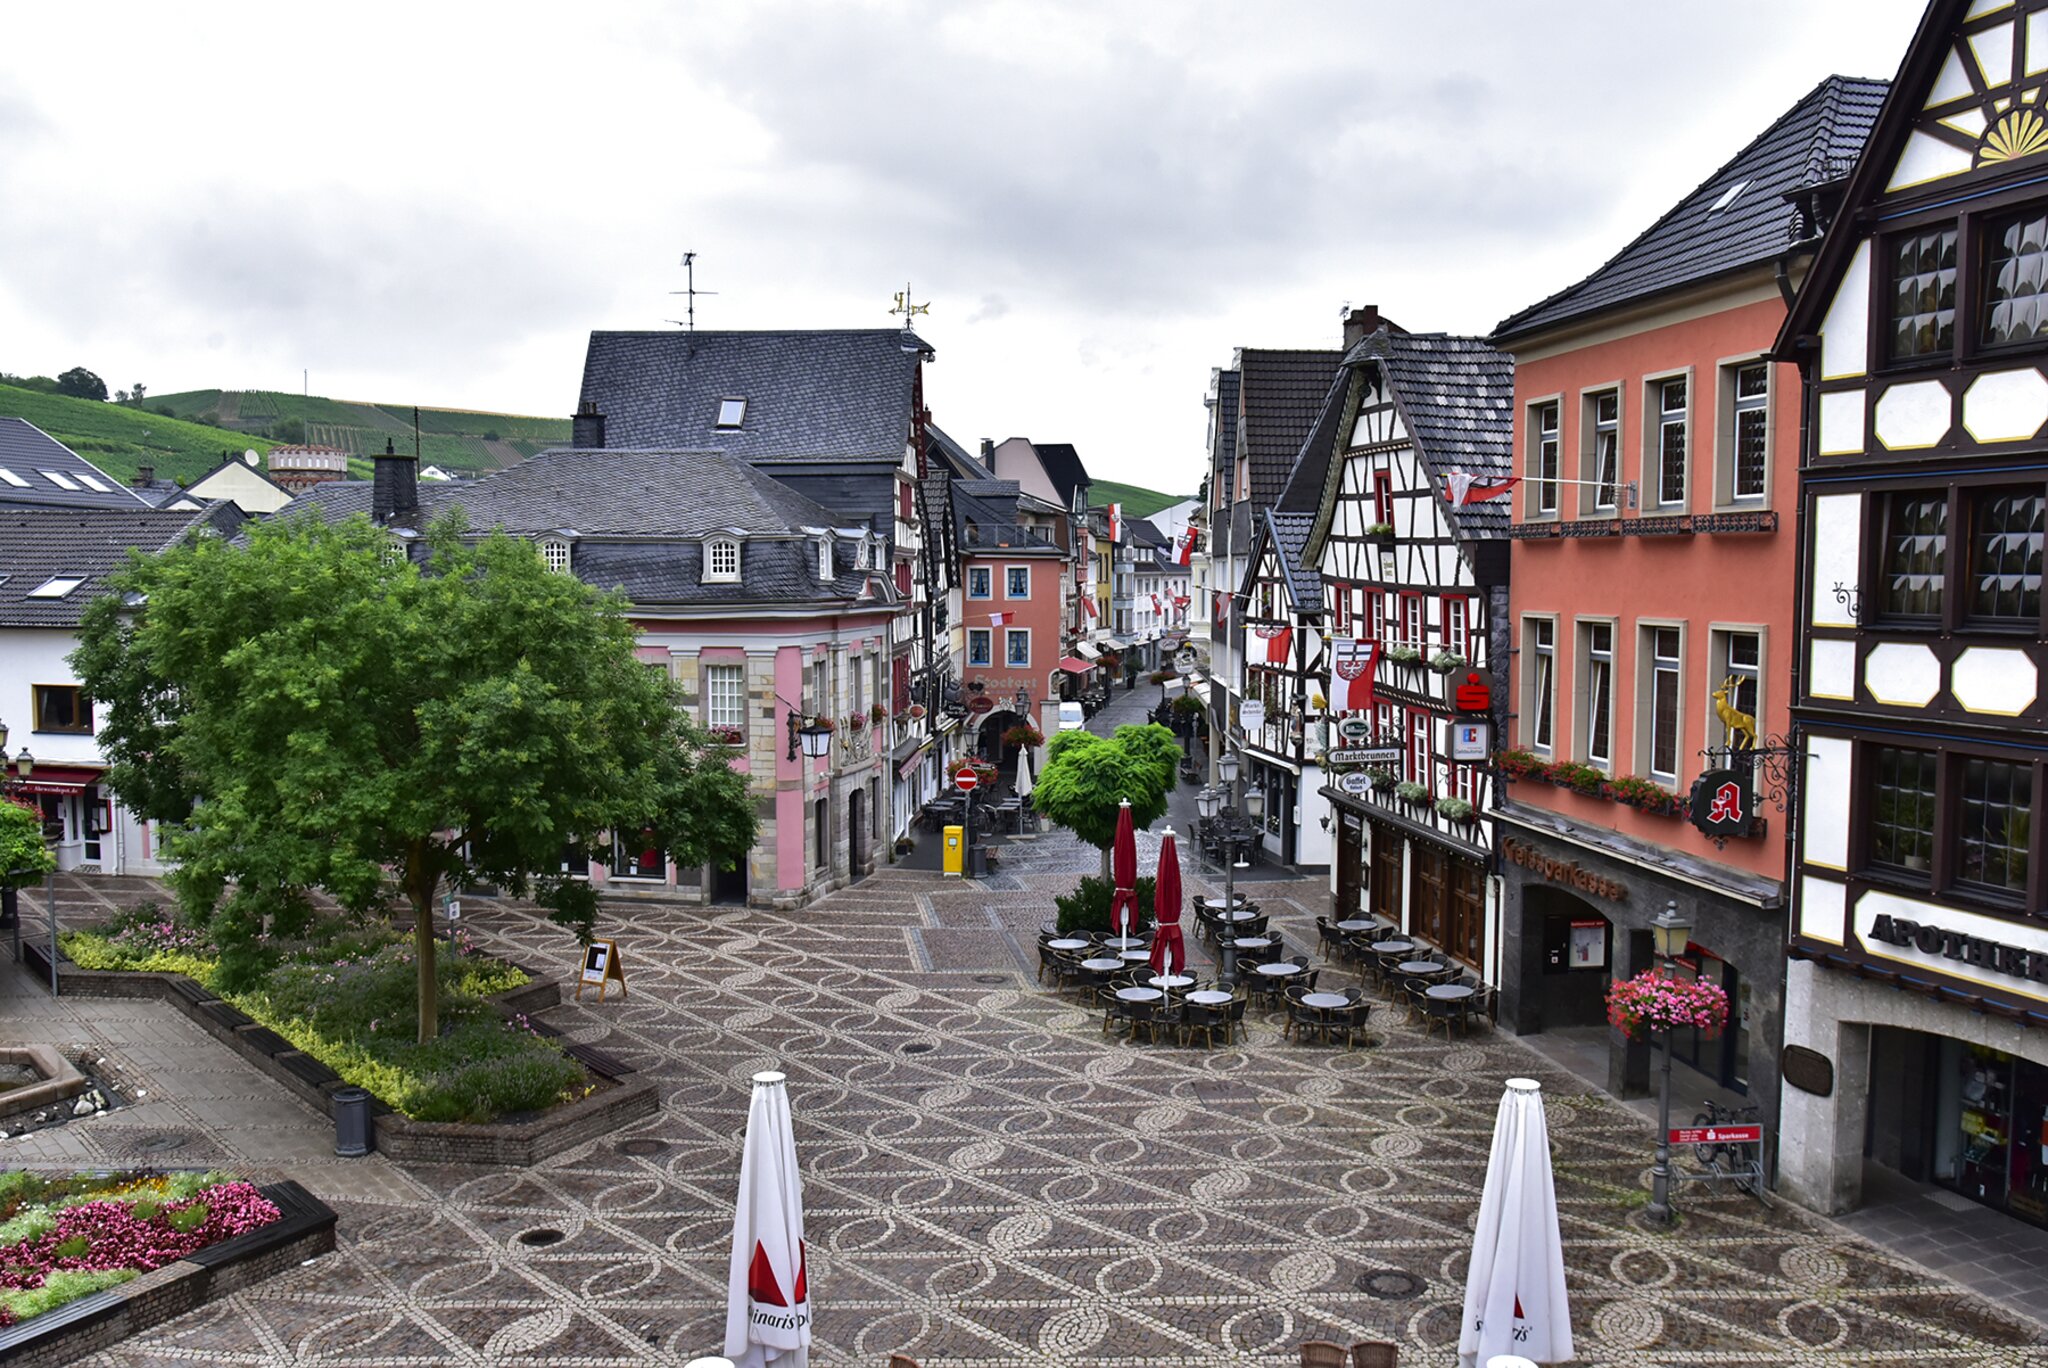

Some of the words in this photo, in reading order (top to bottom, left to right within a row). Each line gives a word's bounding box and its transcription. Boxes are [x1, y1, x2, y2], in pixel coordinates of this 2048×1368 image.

[1335, 751, 1395, 762] Marktbrunnen
[1346, 776, 1366, 785] Gaffel
[1503, 835, 1627, 903] Kreissparkasse
[1718, 1132, 1748, 1140] Sparkasse
[748, 1304, 796, 1330] inaris
